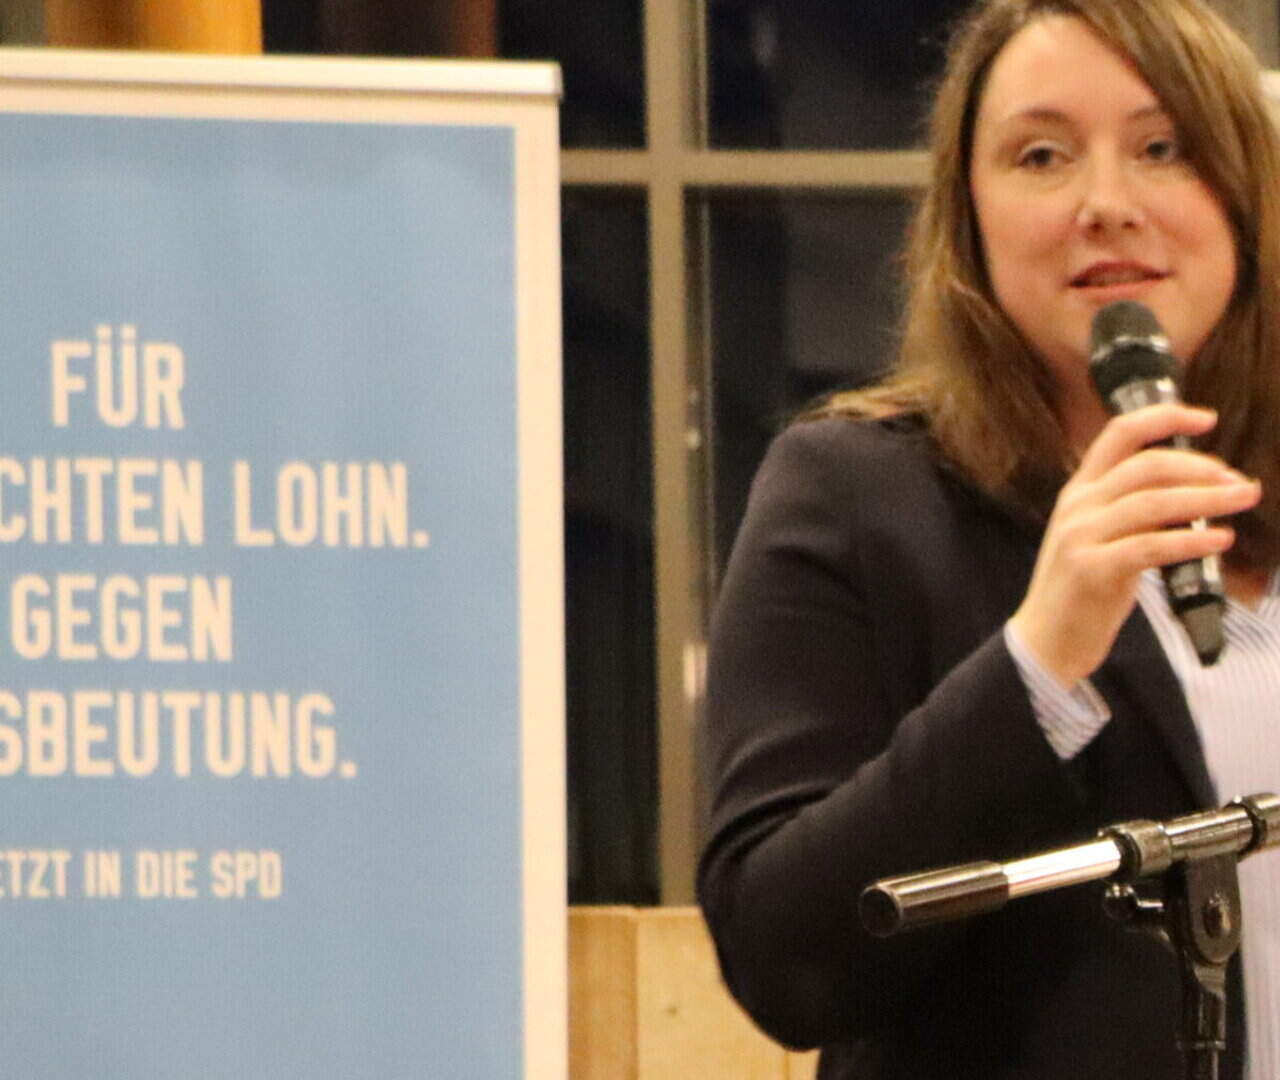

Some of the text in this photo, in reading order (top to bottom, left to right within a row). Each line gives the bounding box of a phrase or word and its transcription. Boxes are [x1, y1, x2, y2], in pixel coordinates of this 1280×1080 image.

[52, 325, 184, 429] FÜR
[235, 461, 428, 547] LOHN.
[11, 575, 232, 661] GEGEN
[0, 850, 281, 898] TZT IN DIE SPD
